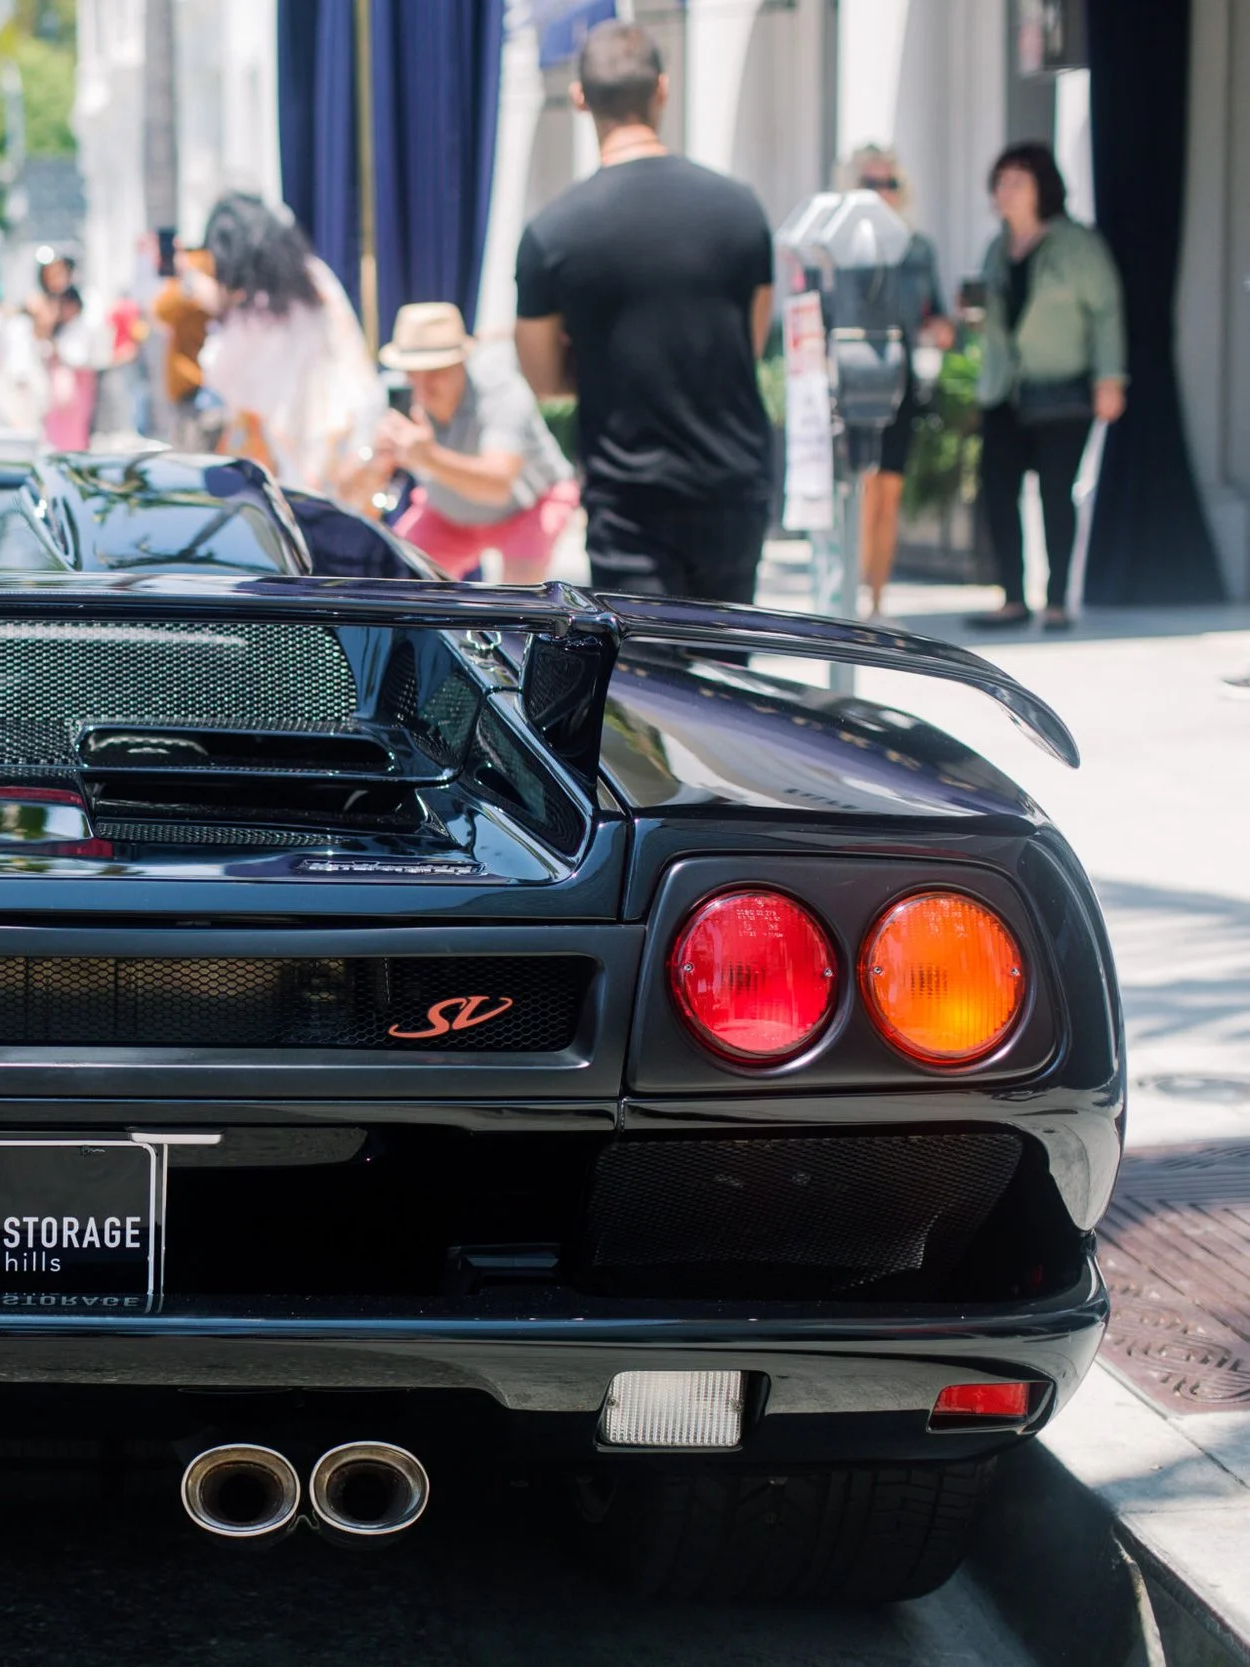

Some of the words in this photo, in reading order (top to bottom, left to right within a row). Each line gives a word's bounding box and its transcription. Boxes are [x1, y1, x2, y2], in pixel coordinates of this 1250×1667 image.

[388, 995, 513, 1038] SV
[3, 1216, 141, 1248] STORAGE
[5, 1251, 61, 1272] hills
